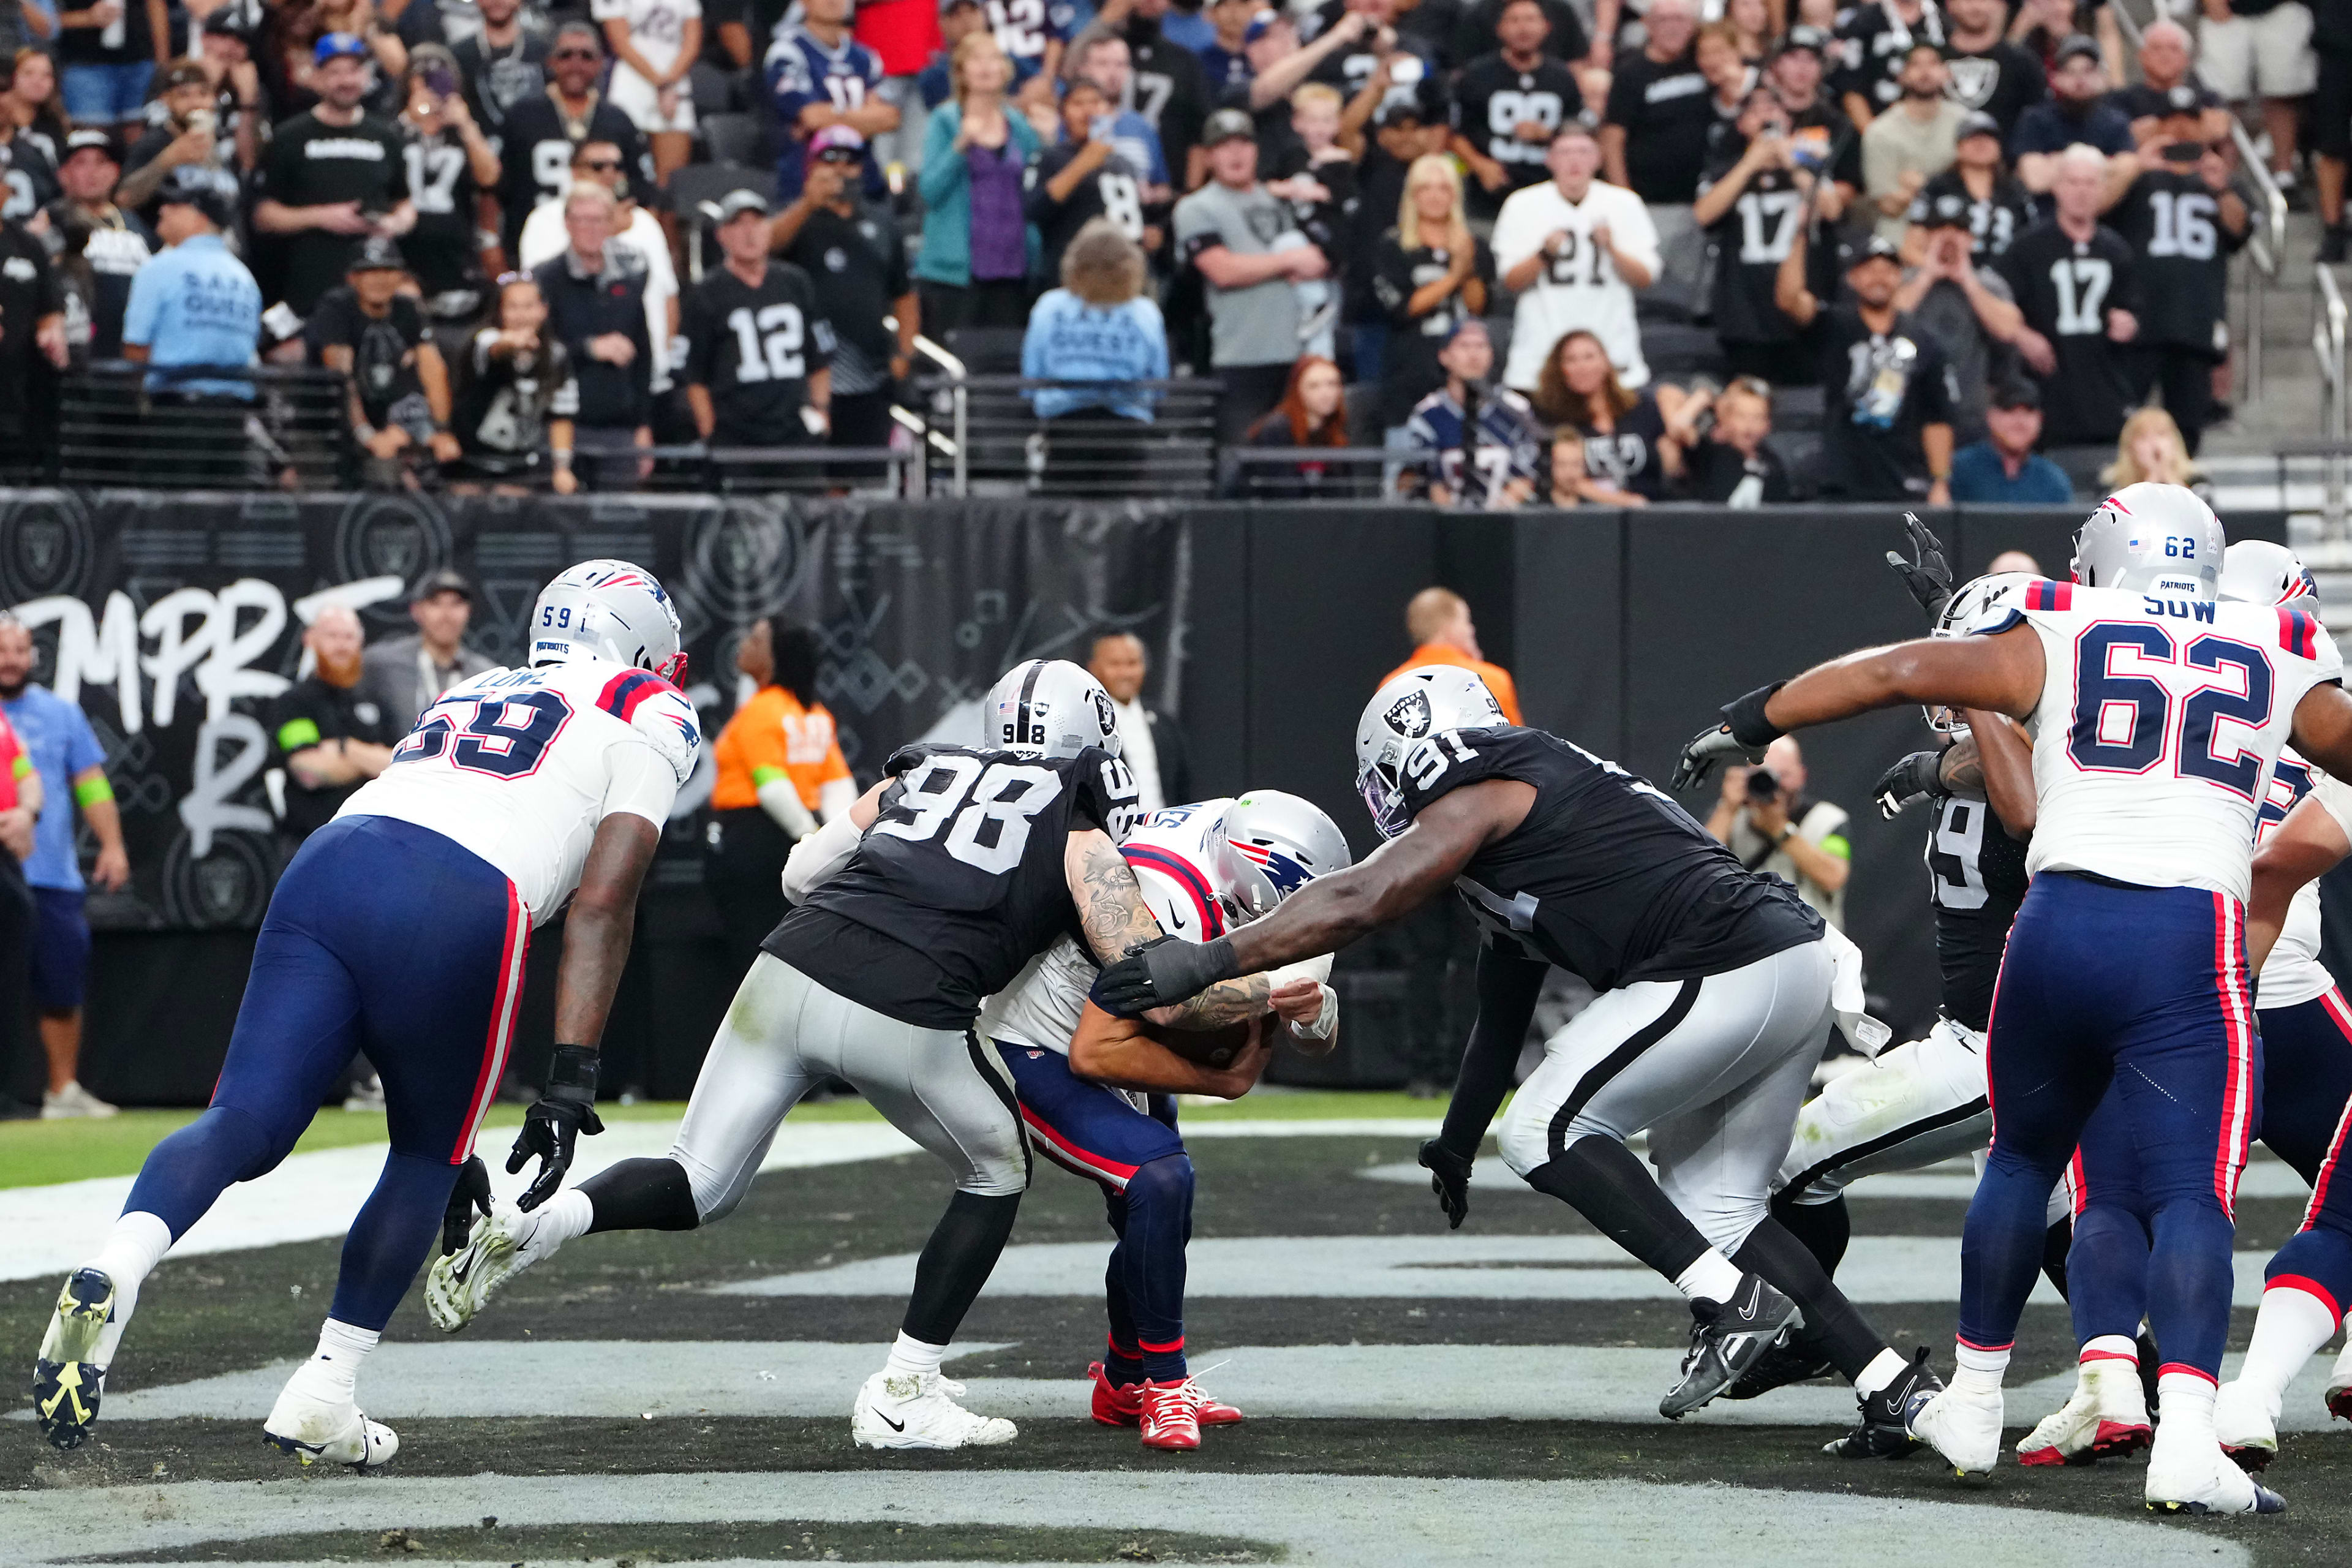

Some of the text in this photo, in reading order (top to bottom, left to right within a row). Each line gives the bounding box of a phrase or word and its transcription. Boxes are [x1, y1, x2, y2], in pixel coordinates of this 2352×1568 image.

[823, 74, 865, 115] 11
[402, 144, 466, 213] 17
[1736, 191, 1802, 265] 17
[2147, 189, 2218, 260] 16
[2049, 258, 2113, 335] 17
[729, 303, 805, 382] 12
[2165, 536, 2195, 559] 62
[543, 606, 571, 628] 59
[2160, 581, 2195, 592] PATRIOTS
[390, 688, 575, 781] 59
[1387, 692, 1422, 718] RAIDERS
[2067, 619, 2274, 804] 62
[1407, 728, 1480, 791] 91
[870, 755, 1063, 875] 98
[1100, 757, 1139, 846] 98
